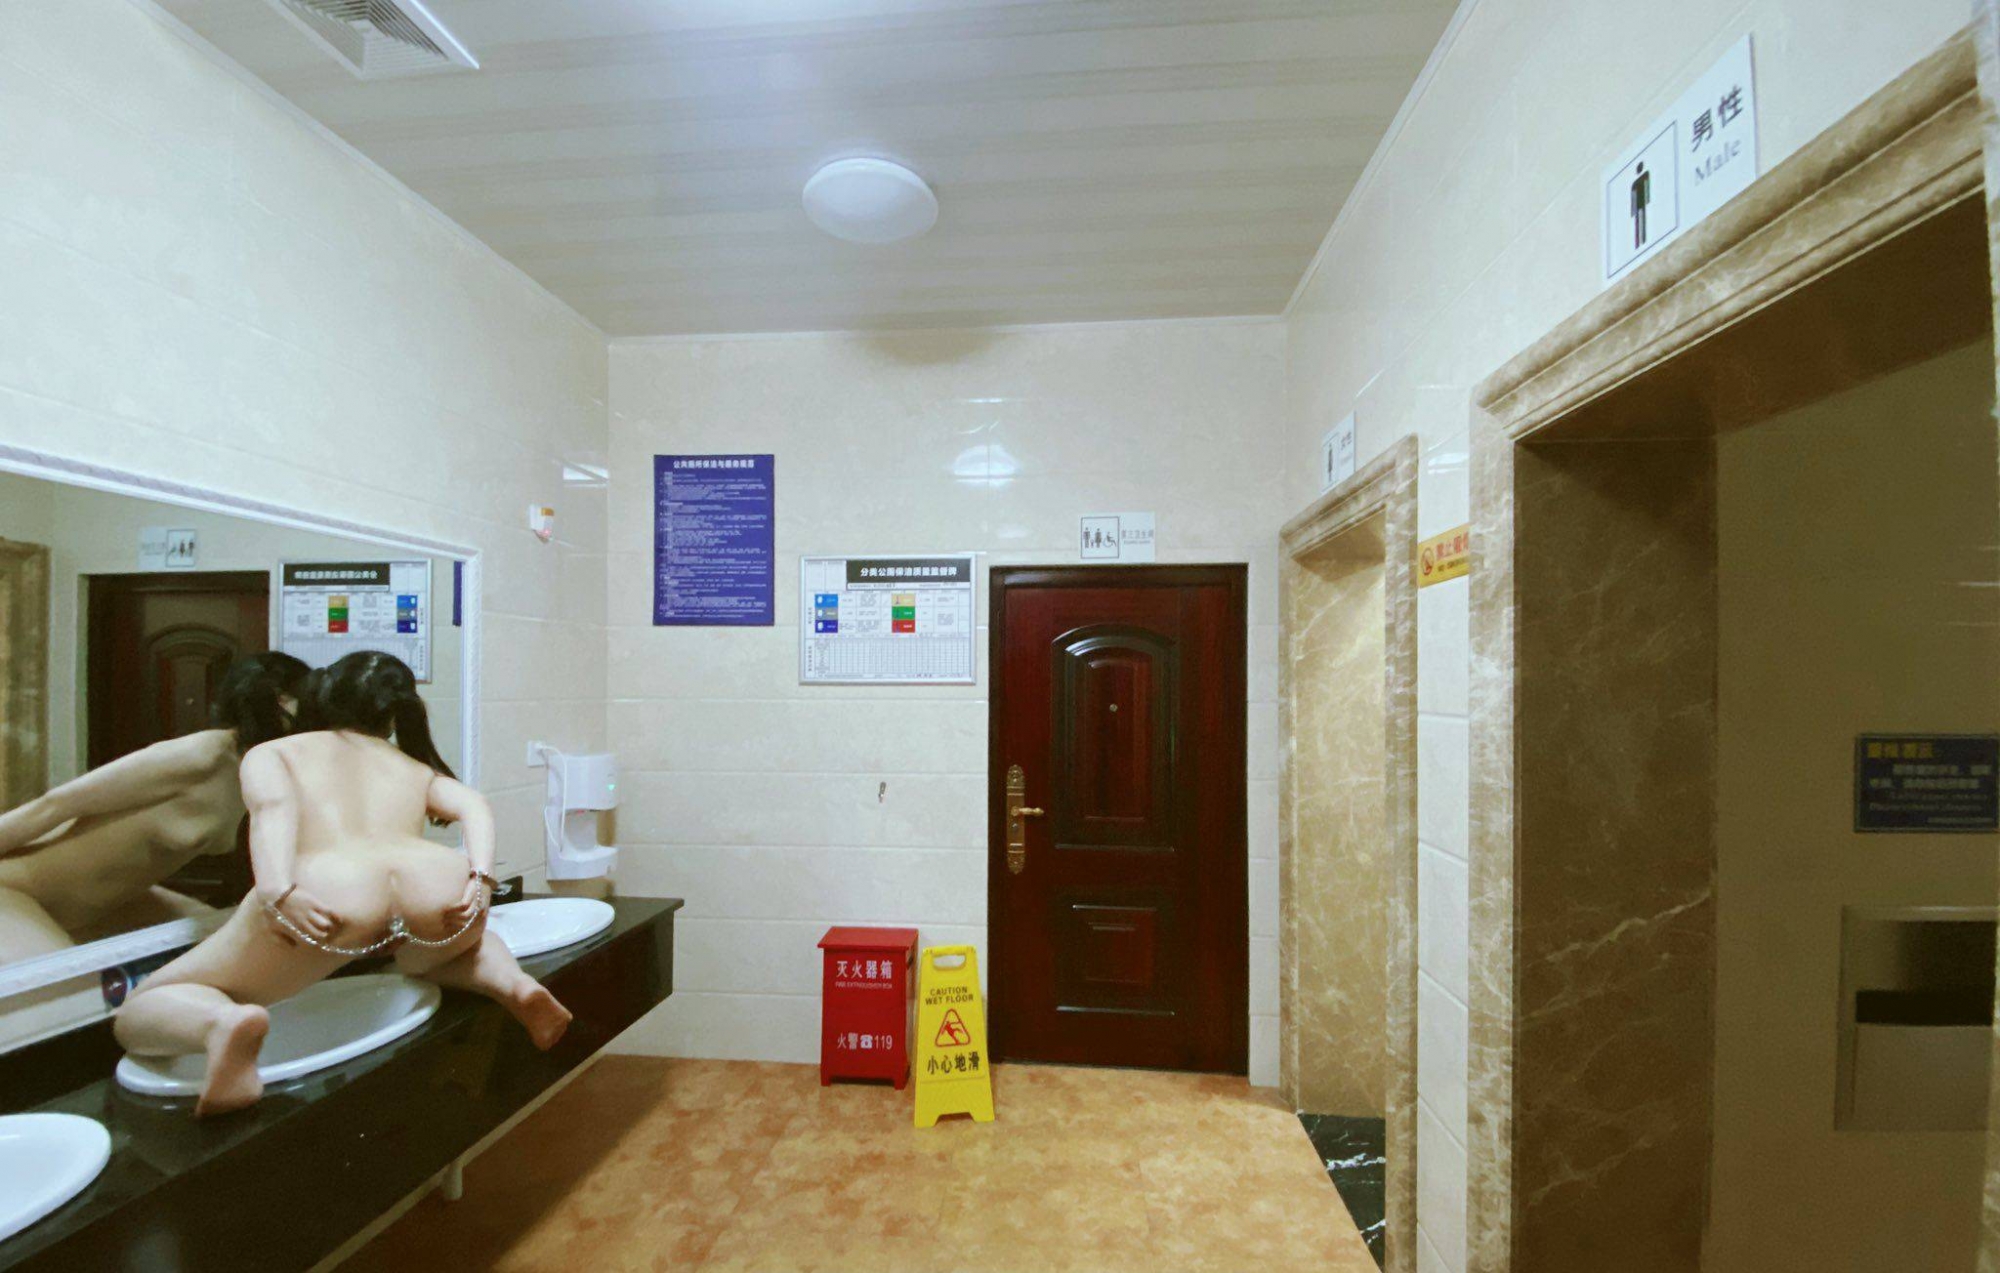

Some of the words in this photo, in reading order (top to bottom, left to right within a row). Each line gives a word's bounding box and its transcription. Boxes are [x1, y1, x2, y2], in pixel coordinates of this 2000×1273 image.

[1691, 84, 1743, 153] 男性
[1694, 139, 1742, 186] Male
[836, 960, 893, 979] 灭火器箱
[925, 996, 943, 1005] WET
[945, 994, 974, 1004] FLOOR
[930, 986, 968, 996] CAUTION
[837, 1033, 858, 1050] 火警
[874, 1034, 893, 1050] 119
[927, 1051, 980, 1075] 小心地滑
